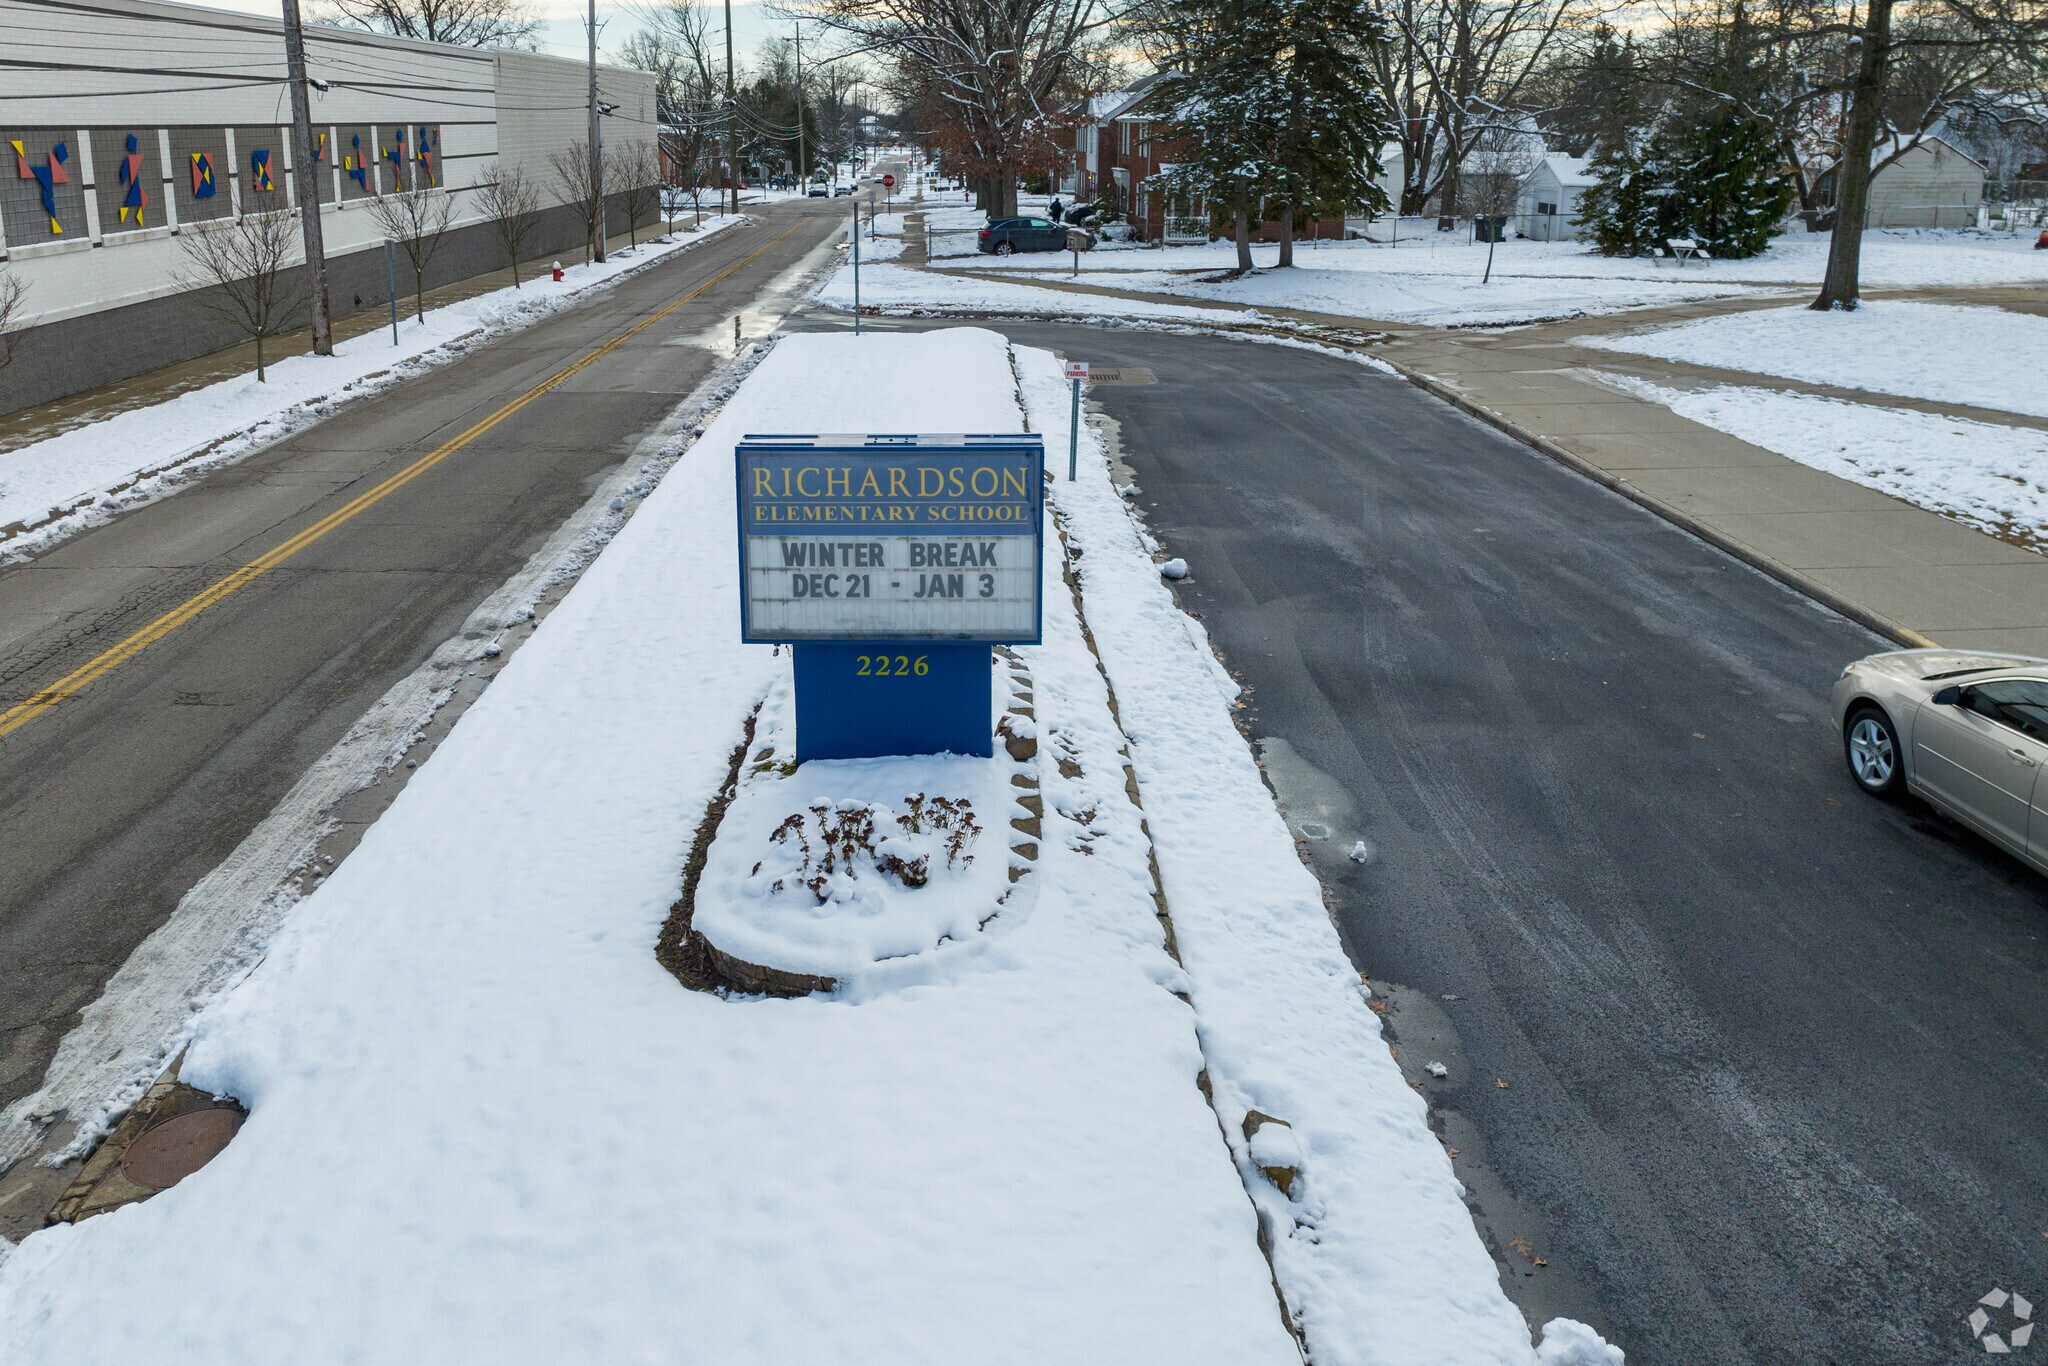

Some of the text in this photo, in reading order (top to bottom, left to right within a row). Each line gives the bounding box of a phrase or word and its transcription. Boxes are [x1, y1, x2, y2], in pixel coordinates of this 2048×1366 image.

[752, 467, 1029, 498] RICHARDSON
[755, 505, 1028, 521] ELEMENTARY SCHOOL
[782, 543, 997, 567] WINTER BREAK
[793, 574, 840, 598] DEC
[846, 574, 870, 598] 21
[913, 574, 964, 598] JAN
[979, 573, 995, 598] 3
[856, 655, 930, 676] 2226
